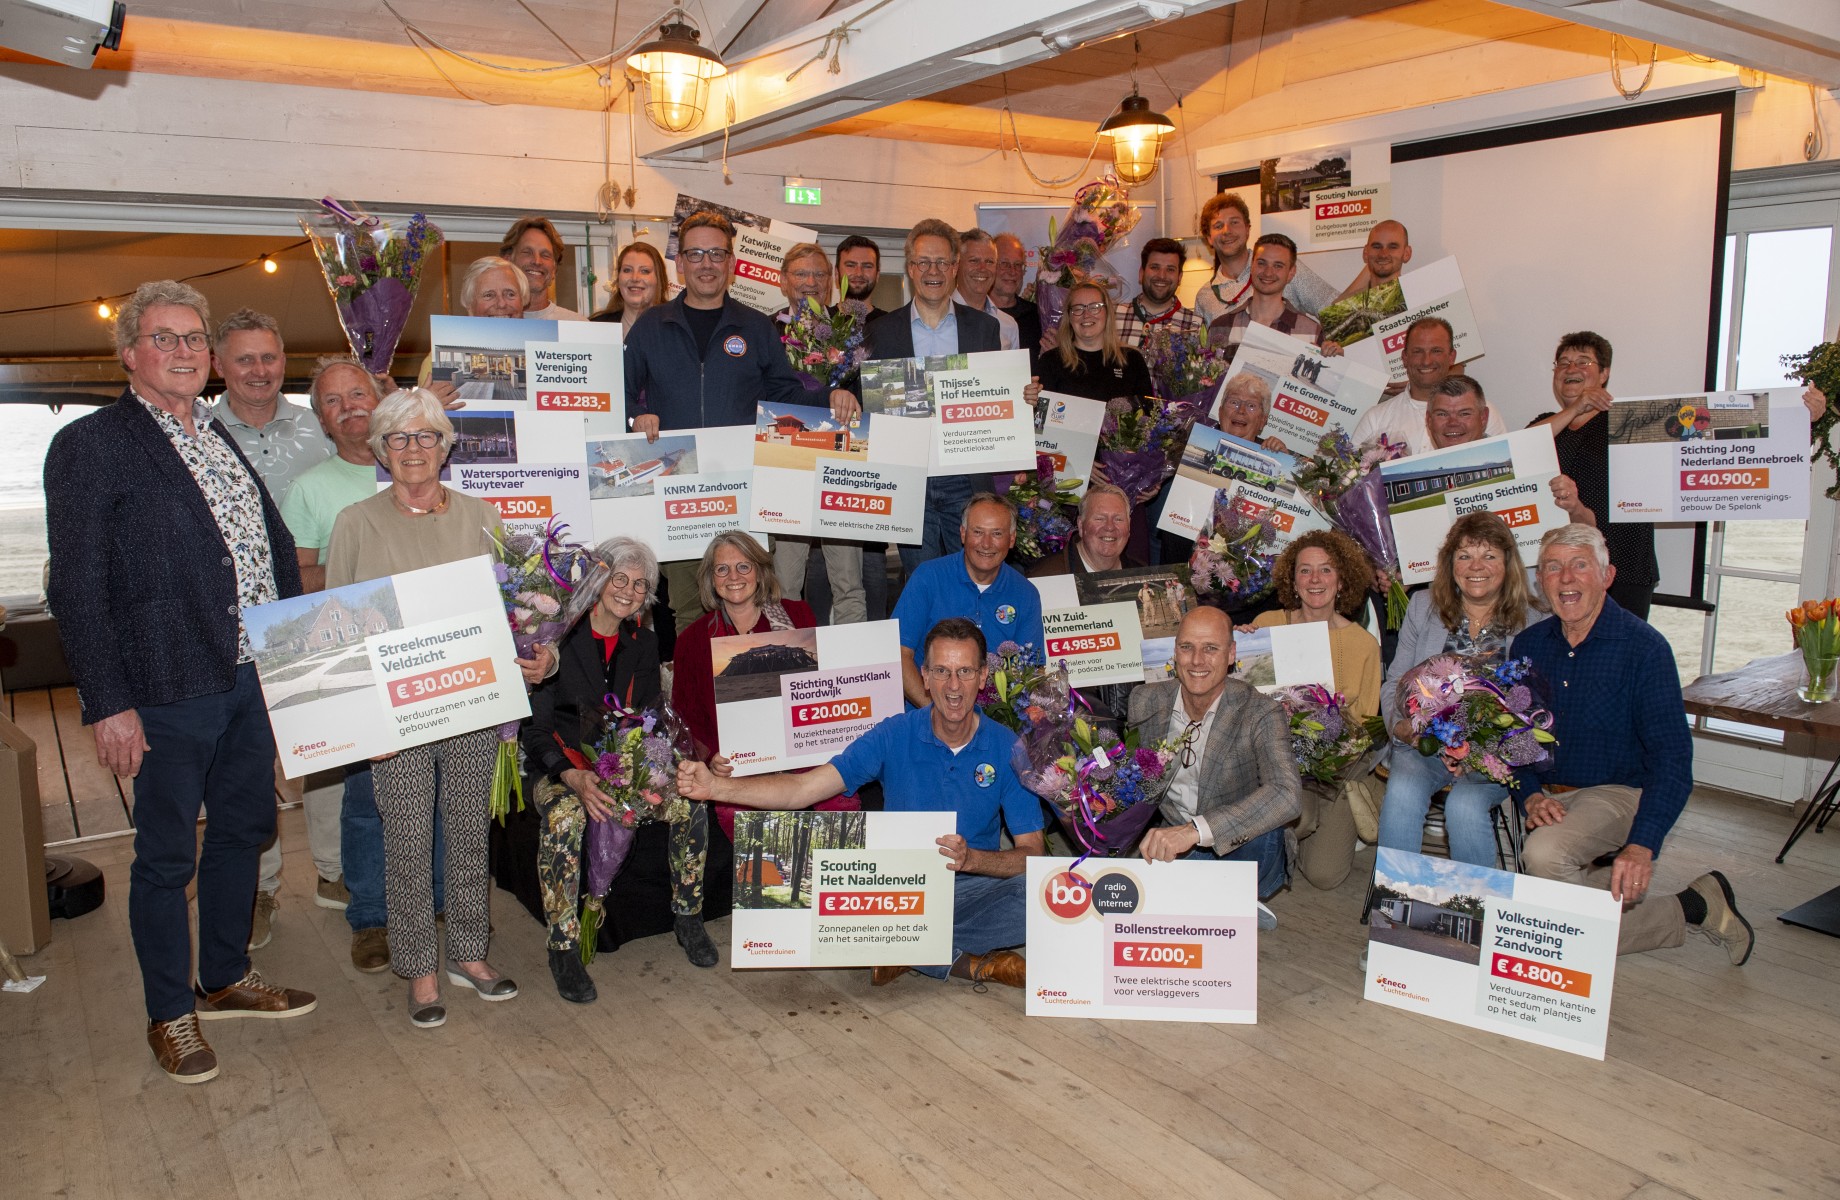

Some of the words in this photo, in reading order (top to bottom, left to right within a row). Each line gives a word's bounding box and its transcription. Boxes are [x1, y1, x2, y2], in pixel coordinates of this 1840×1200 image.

[1316, 192, 1345, 200] Scouting
[1348, 188, 1378, 197] Norvicus
[1319, 207, 1325, 216] €
[1327, 203, 1367, 216] 28.000,-
[742, 235, 781, 252] Katwijkse
[739, 264, 747, 273] €
[1379, 301, 1449, 333] Staatsbosbeheer
[1388, 339, 1395, 349] €
[535, 351, 592, 362] Watersport
[536, 363, 587, 374] Vereniging
[536, 374, 587, 383] Zandvoort
[941, 390, 959, 399] Hof
[962, 388, 1010, 398] Heemtuin
[1283, 380, 1298, 392] Het
[1300, 387, 1328, 403] Groene
[1329, 399, 1357, 415] Strand
[541, 395, 549, 406] €
[552, 396, 606, 409] 43.283,-
[946, 408, 954, 419] €
[957, 405, 1008, 418] 20.000,-
[1278, 398, 1286, 407] €
[1289, 401, 1323, 423] 1.500,-
[943, 428, 991, 437] Verduurzamen
[944, 436, 1005, 445] bezoekerscentrum
[944, 444, 995, 453] instructielokaal
[1681, 445, 1727, 455] Stichting
[1730, 444, 1755, 454] Jong
[1681, 455, 1735, 467] Nederland
[1738, 454, 1804, 464] Bennebroek
[461, 468, 579, 480] Watersportvereniging
[823, 466, 880, 479] Zandvoortse
[462, 480, 524, 491] Skuytevaer
[823, 476, 897, 491] Reddingsbrigade
[1686, 475, 1695, 485] €
[1700, 473, 1761, 487] 40.900,-
[664, 485, 696, 495] KNRM
[698, 481, 747, 493] Zandvoort
[1454, 492, 1493, 505] Scouting
[1495, 484, 1537, 497] Stichting
[825, 495, 832, 506] €
[835, 496, 885, 511] 4.121,80
[1238, 486, 1311, 516] Outdoor4disabled
[1741, 493, 1792, 502] verenigings-
[670, 504, 678, 515] €
[681, 500, 732, 514] 23.500,-
[1681, 503, 1712, 512] gebouw
[1729, 503, 1761, 512] Spelonk
[667, 522, 715, 531] Zonnepanelen
[820, 519, 837, 527] Twee
[839, 521, 873, 530] elektrische
[891, 525, 913, 533] fietsen
[1043, 615, 1061, 623] IVN
[1063, 612, 1087, 621] Zuid-
[1045, 619, 1113, 634] Kennemerland
[378, 623, 482, 657] Streekmuseum
[1052, 642, 1060, 652] €
[1062, 637, 1114, 650] 4.985,50
[381, 649, 446, 673] Veldzicht
[1078, 666, 1104, 674] podcast
[397, 684, 410, 699] €
[414, 667, 487, 692] 30.000,-
[790, 679, 833, 690] Stichting
[836, 670, 891, 685] KunstKlank
[791, 687, 841, 701] Noordwijk
[396, 699, 466, 724] Verduurzamen
[468, 694, 485, 706] van
[487, 690, 500, 701] de
[799, 709, 808, 721] €
[811, 702, 866, 720] 20.000,-
[399, 715, 450, 736] gebouwen
[299, 739, 327, 752] Eneco
[820, 736, 843, 745] strand
[303, 741, 356, 760] Luchterduinen
[737, 755, 776, 765] Luchterduinen
[820, 860, 877, 873] Scouting
[820, 875, 844, 886] Het
[847, 874, 926, 886] Naaldenveld
[1104, 883, 1127, 891] radio
[1052, 879, 1087, 905] bo
[825, 898, 835, 910] €
[840, 896, 919, 912] 20.716,57
[1098, 899, 1133, 908] internet
[818, 924, 880, 934] Zonnepanelen
[882, 925, 893, 933] op
[896, 924, 910, 932] het
[913, 924, 928, 932] dak
[1497, 909, 1585, 937] Volkstuinder-
[1114, 923, 1236, 939] Bollenstreekomroep
[1495, 924, 1563, 949] vereniging
[836, 935, 850, 943] het
[853, 934, 920, 944] sanitairgebouw
[1494, 936, 1563, 961] Zandvoort
[1122, 947, 1133, 961] €
[1138, 947, 1195, 965] 7.000,-
[1497, 958, 1509, 974] €
[1512, 963, 1573, 990] 4.800,-
[1114, 976, 1138, 984] Twee
[1140, 977, 1190, 986] elektrische
[1192, 979, 1232, 988] scooters
[1382, 977, 1406, 990] Eneco
[1136, 988, 1200, 998] verslaggevers
[1384, 986, 1430, 1003] Luchterduinen
[1489, 982, 1558, 1005] Verduurzamen
[1560, 999, 1596, 1014] kantine
[1487, 1004, 1500, 1015] op
[1501, 1006, 1517, 1018] het
[1519, 1011, 1537, 1023] dak
[1488, 993, 1507, 1004] met
[1509, 998, 1541, 1013] sedum
[1543, 1005, 1582, 1023] plantjes
